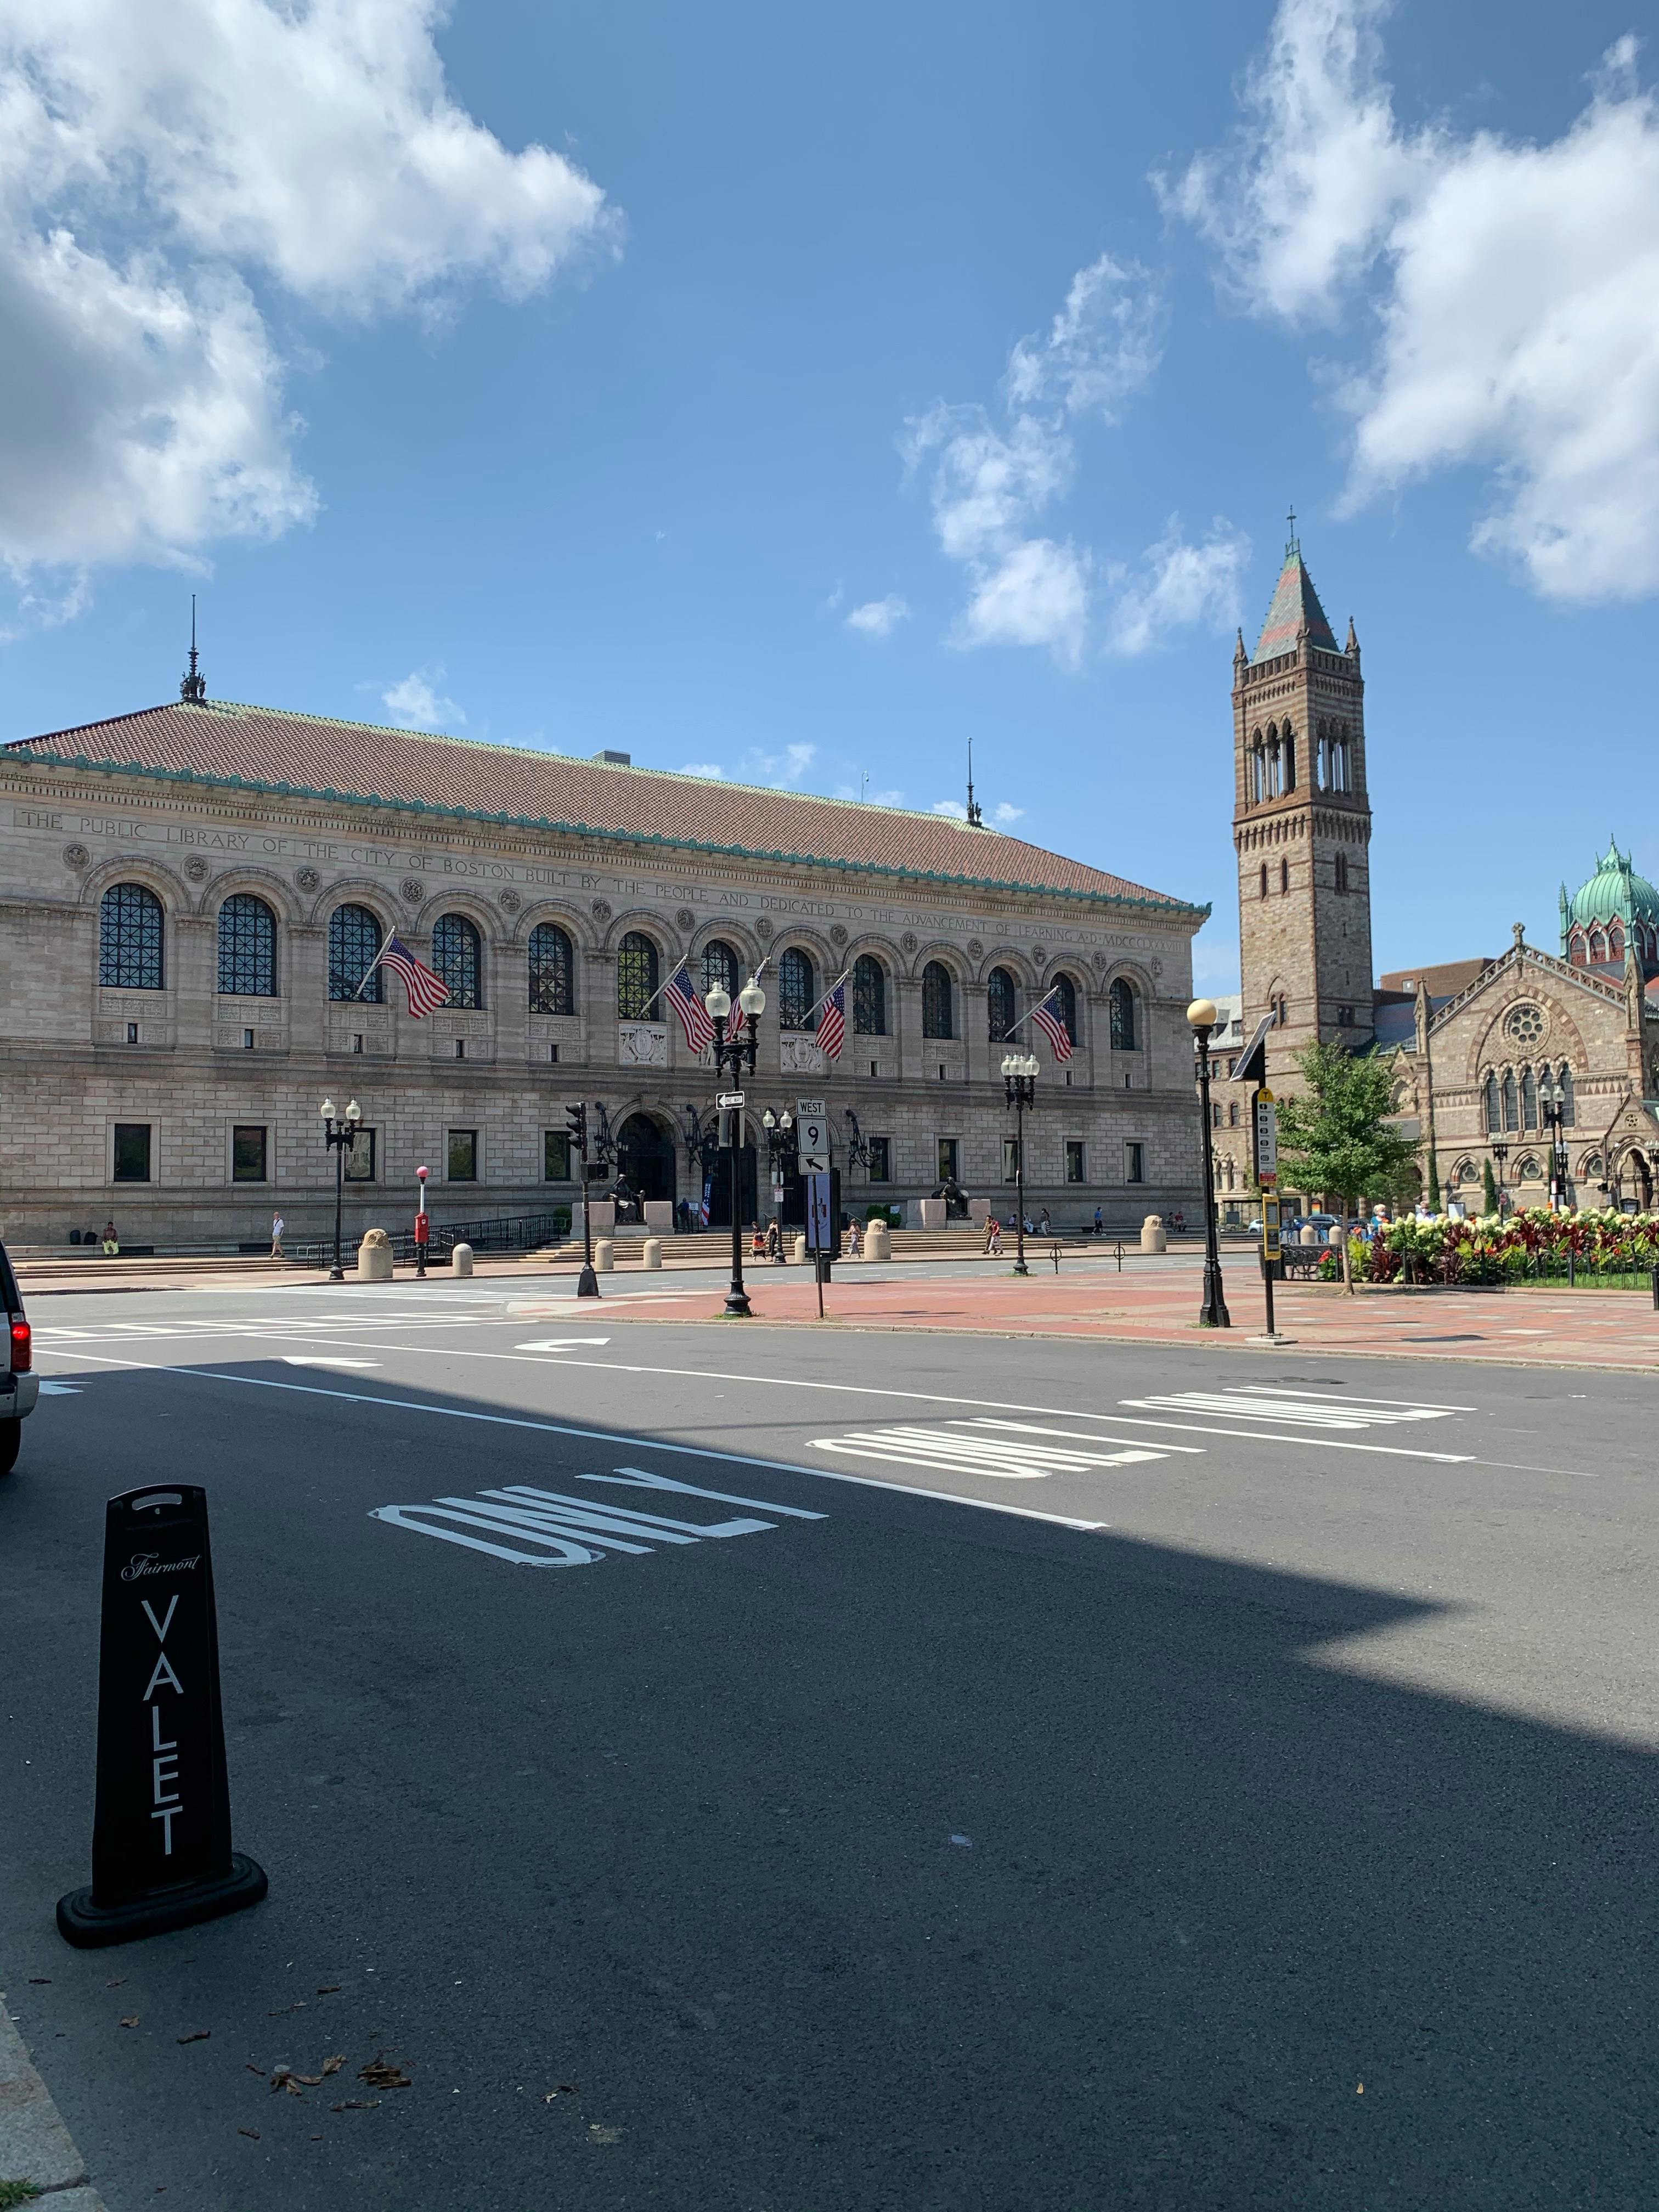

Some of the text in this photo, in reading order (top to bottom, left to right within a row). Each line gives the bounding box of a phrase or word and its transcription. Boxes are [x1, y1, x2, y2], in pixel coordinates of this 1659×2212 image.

[22, 811, 63, 829] THE
[80, 818, 147, 838] PUBLIC
[167, 827, 249, 849] LIBRARY
[262, 839, 288, 853] OF
[303, 843, 339, 860] THE
[351, 849, 395, 865] CITY
[409, 855, 432, 869] OF
[443, 859, 515, 878] BOSTON
[526, 869, 571, 885] BUILT
[582, 876, 601, 889] BY
[613, 879, 646, 895] THE
[656, 884, 709, 901] PEOPLE
[719, 893, 748, 906] AND
[761, 896, 834, 915] DEDICATED
[845, 906, 862, 918] TO
[870, 909, 895, 922] THE
[903, 913, 987, 932] ADVANCEMENT
[996, 924, 1011, 934] OF
[1018, 925, 1073, 941] LEARNING
[800, 1102, 822, 1113] WEST
[808, 1126, 819, 1146] 9
[1118, 1386, 1478, 1428] ONLY
[805, 1418, 1207, 1478] ONLY
[366, 1467, 830, 1568] ONLY
[121, 1553, 202, 1582] Fairmont
[141, 1595, 184, 1855] VALET
